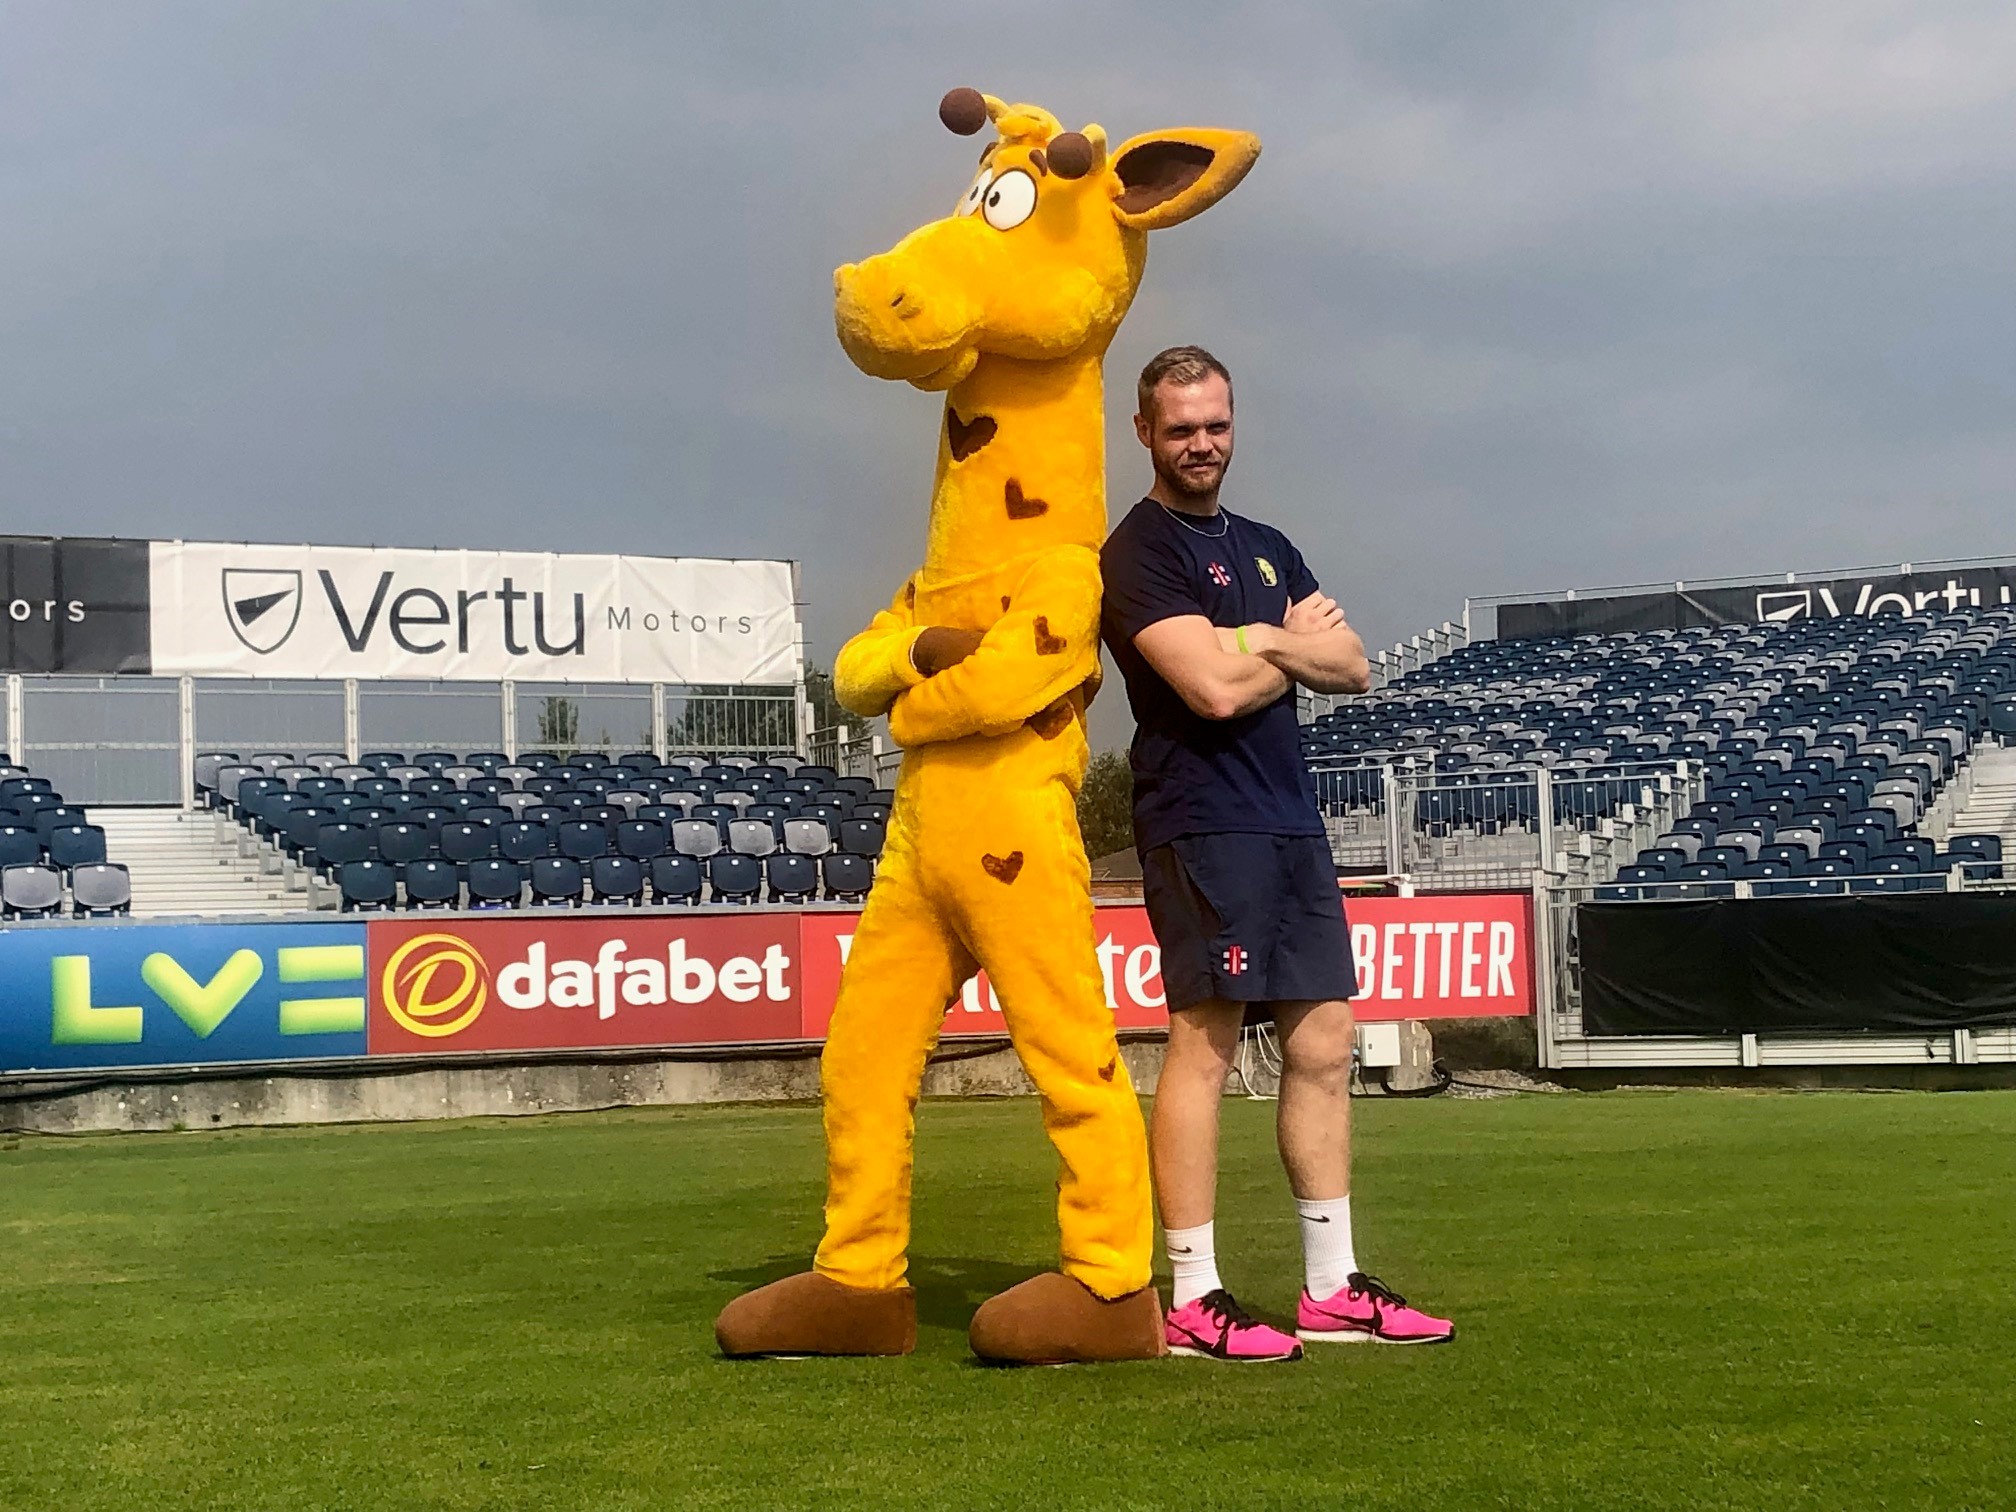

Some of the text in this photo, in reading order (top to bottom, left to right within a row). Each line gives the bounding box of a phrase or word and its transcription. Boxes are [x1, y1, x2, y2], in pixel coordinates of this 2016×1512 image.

[317, 568, 753, 656] Vertu Motors
[496, 938, 791, 1020] dafabet
[1348, 921, 1516, 1000] BETTER
